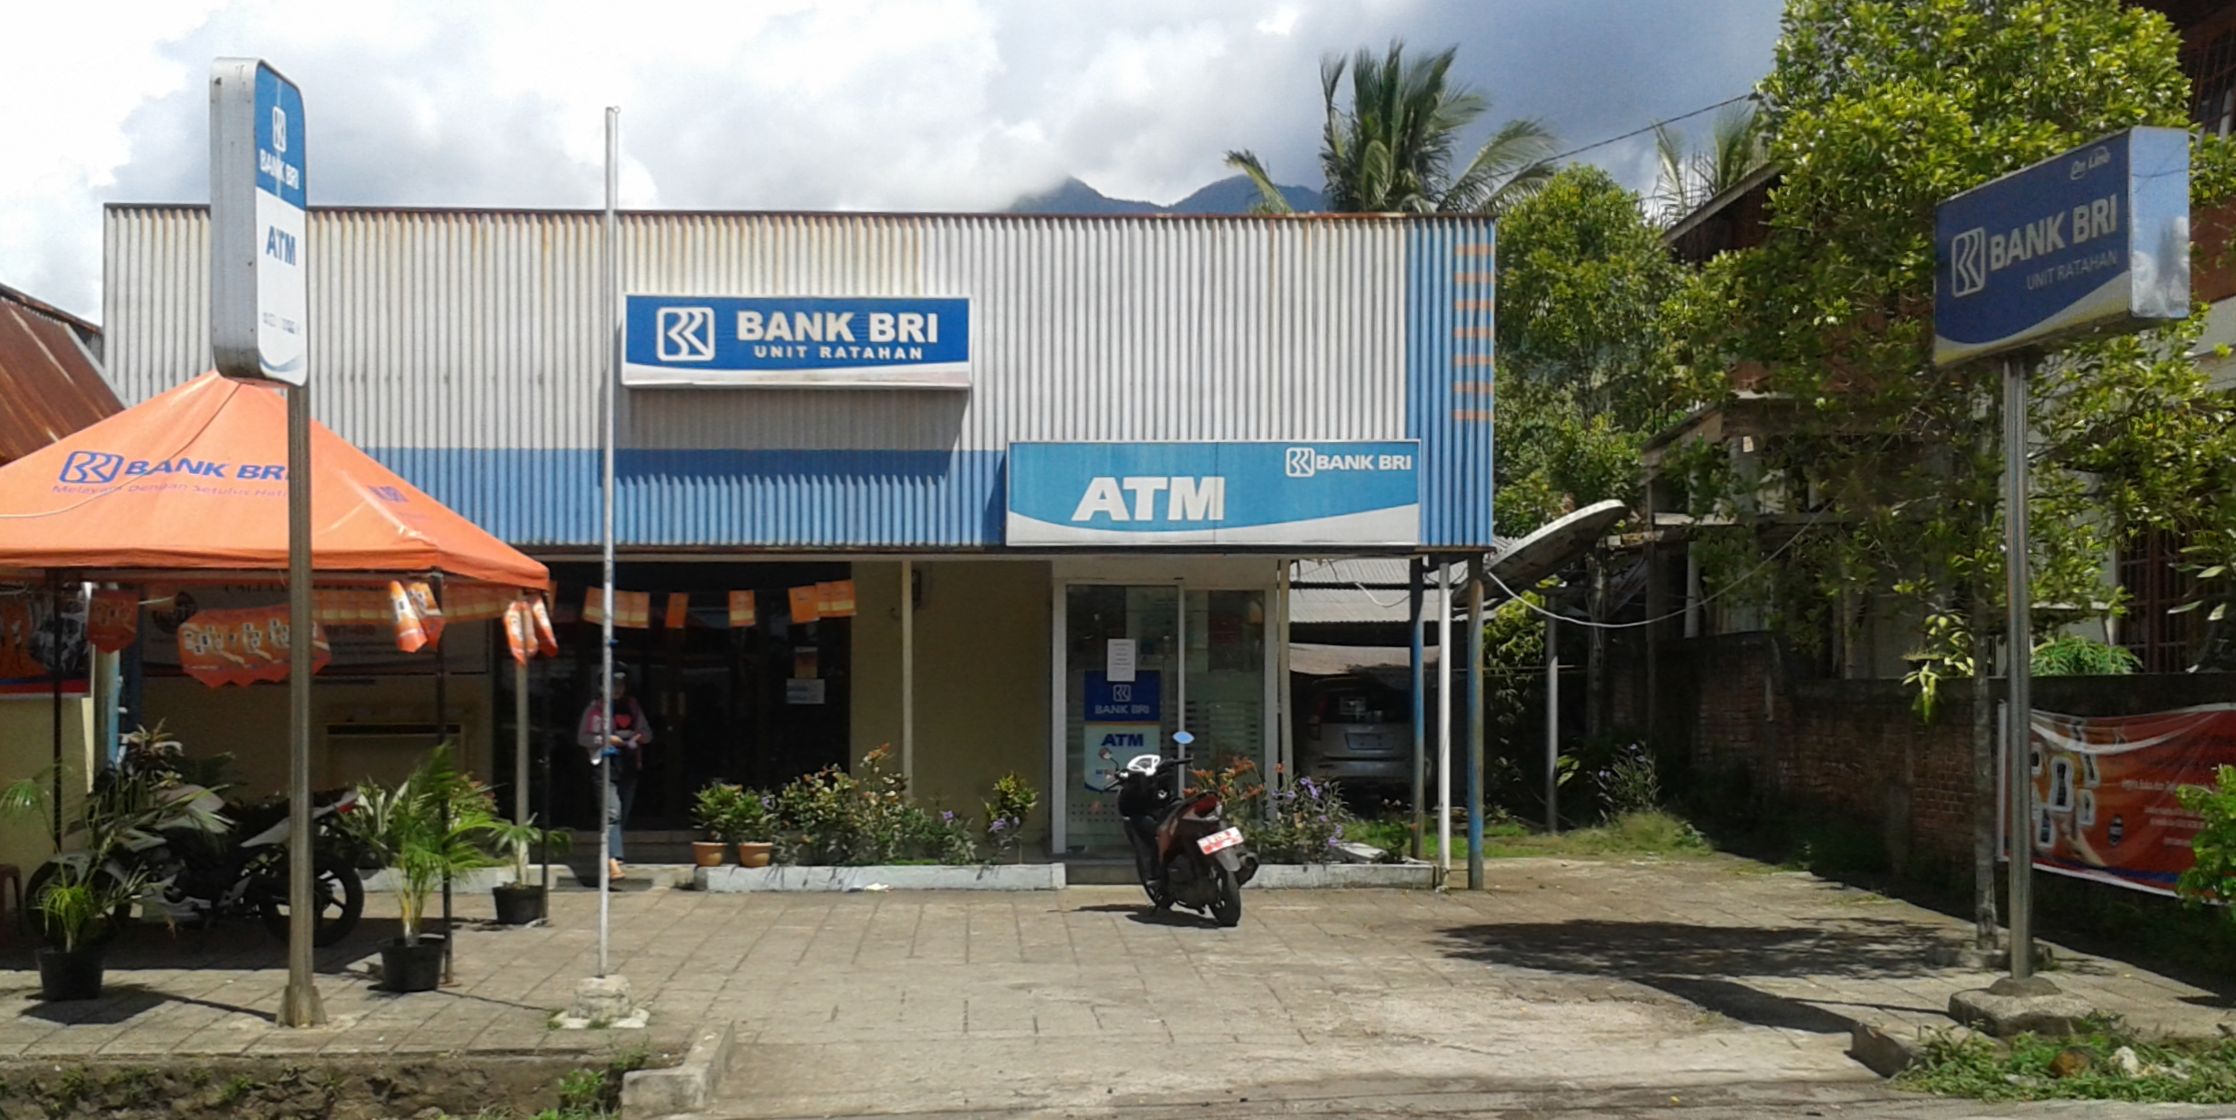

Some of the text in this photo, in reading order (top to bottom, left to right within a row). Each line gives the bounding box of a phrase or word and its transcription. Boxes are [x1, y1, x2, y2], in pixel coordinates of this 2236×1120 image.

[260, 148, 299, 190] BANK BRI
[266, 225, 296, 266] ATM
[1990, 193, 2117, 271] BANK BRI
[2026, 250, 2118, 291] UNIT RATAHAN
[736, 310, 939, 343] BANK BRI
[754, 345, 923, 360] UNIT RATAHAN
[125, 458, 289, 481] BANK BR
[1316, 454, 1412, 471] BANK BRI
[1071, 477, 1225, 521] ATM
[1095, 704, 1150, 714] BANK BRI
[1101, 733, 1144, 747] ATM
